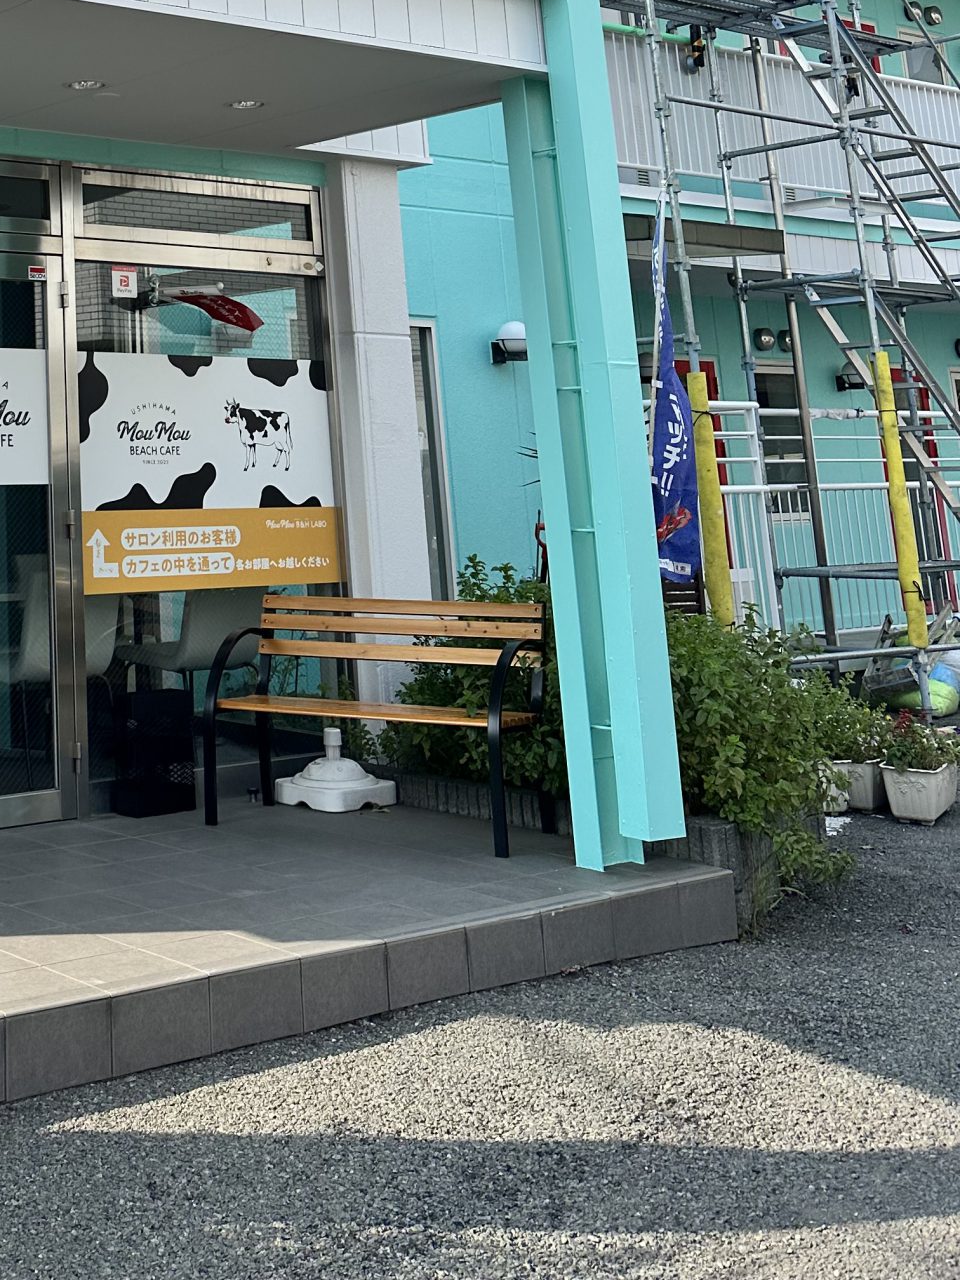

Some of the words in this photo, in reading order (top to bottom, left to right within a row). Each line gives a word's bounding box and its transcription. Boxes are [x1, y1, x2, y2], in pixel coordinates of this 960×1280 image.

[130, 402, 176, 415] USHIHAMA
[129, 446, 157, 456] BEACH
[160, 446, 181, 456] CAFE
[125, 528, 237, 547] サロン利用のお客様
[126, 555, 231, 575] カフェの中を通って
